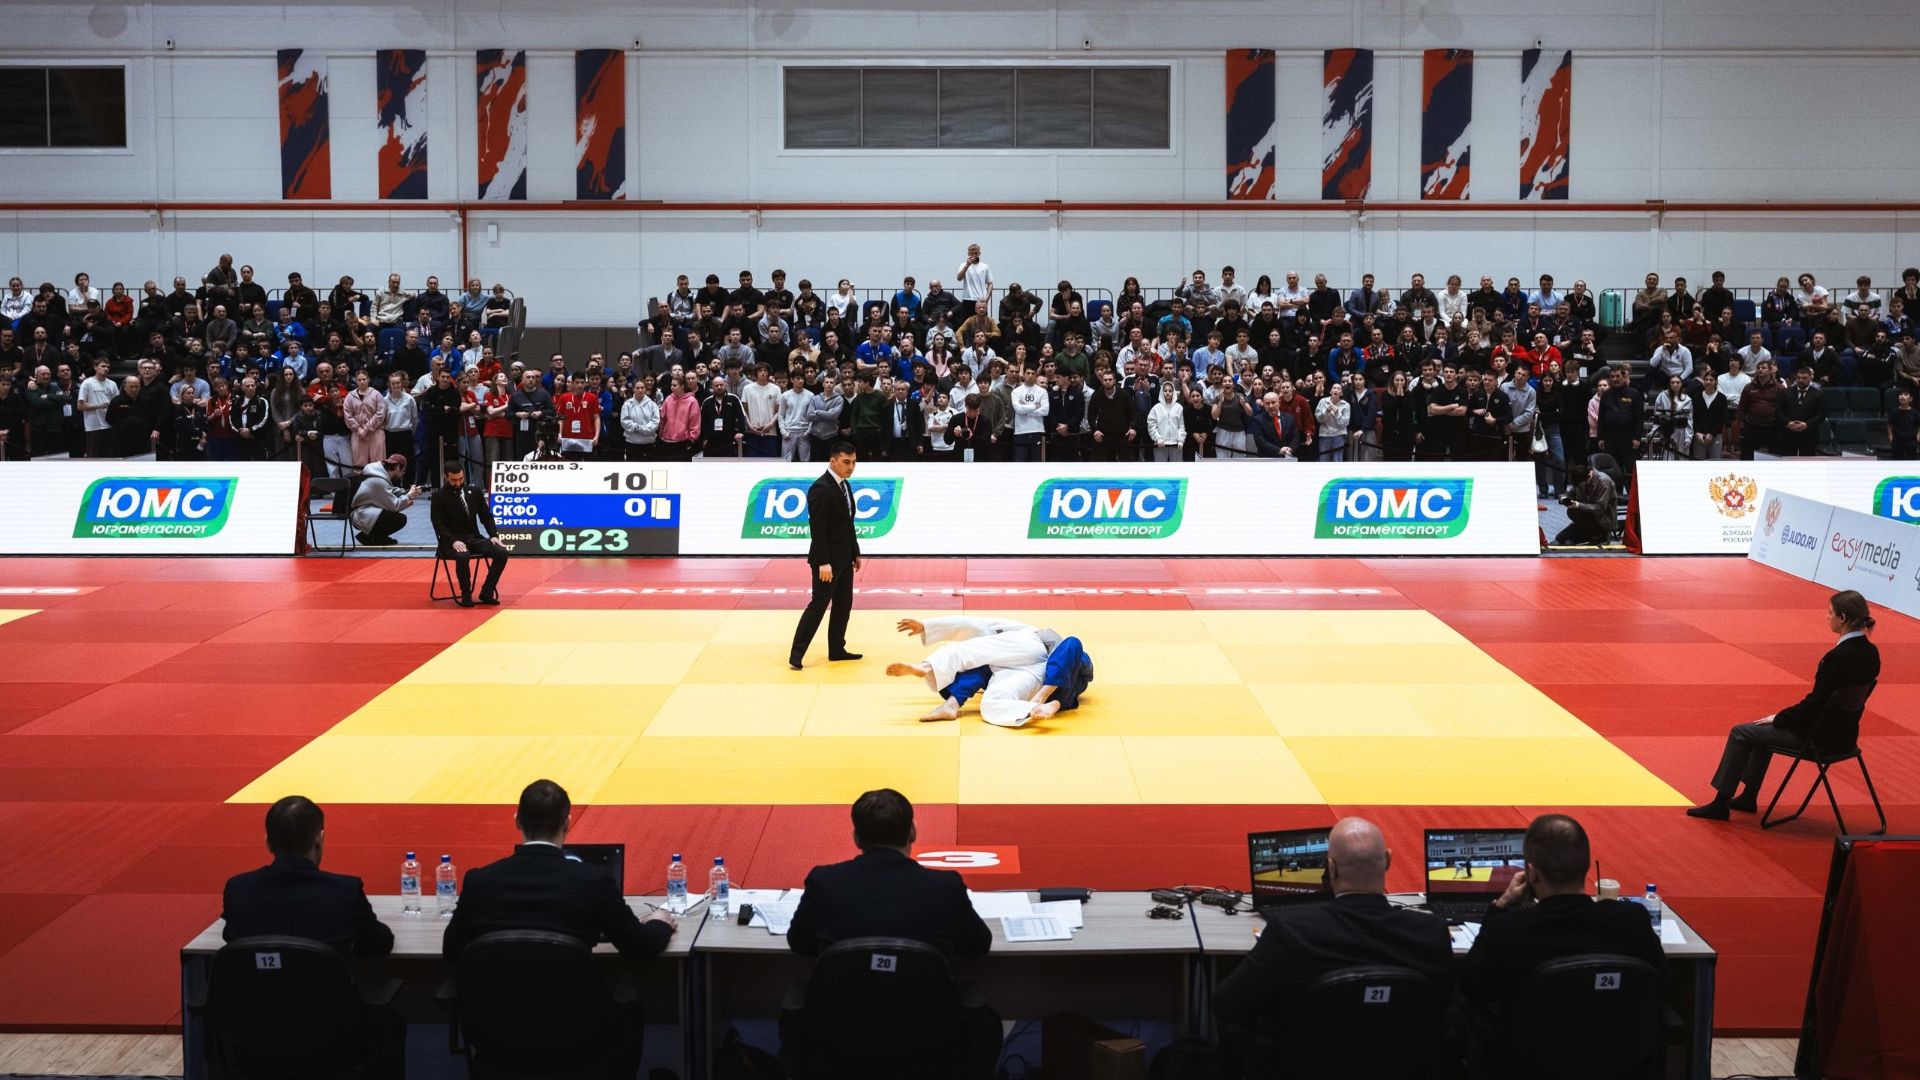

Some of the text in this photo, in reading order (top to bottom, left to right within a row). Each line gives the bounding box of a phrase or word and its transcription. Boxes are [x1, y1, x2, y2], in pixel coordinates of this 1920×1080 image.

[496, 462, 583, 471] Гусейнов Э.
[494, 472, 529, 484] ПФО
[603, 472, 647, 491] 10
[495, 484, 531, 493] Киро
[96, 487, 215, 518] ЮМС
[494, 495, 529, 503] Осет
[764, 488, 881, 519] ЮС
[1050, 488, 1166, 519] ЮМС
[1336, 488, 1452, 519] ЮМС
[492, 505, 537, 516] СКФО
[624, 498, 646, 516] 0
[494, 517, 563, 525] Битиев А.
[497, 532, 532, 541] ронза
[539, 529, 629, 551] 0:23
[916, 851, 1000, 868] 3
[261, 956, 276, 967] 12
[876, 957, 891, 969] 20
[1600, 975, 1615, 987] 24
[1370, 989, 1385, 1001] 21
